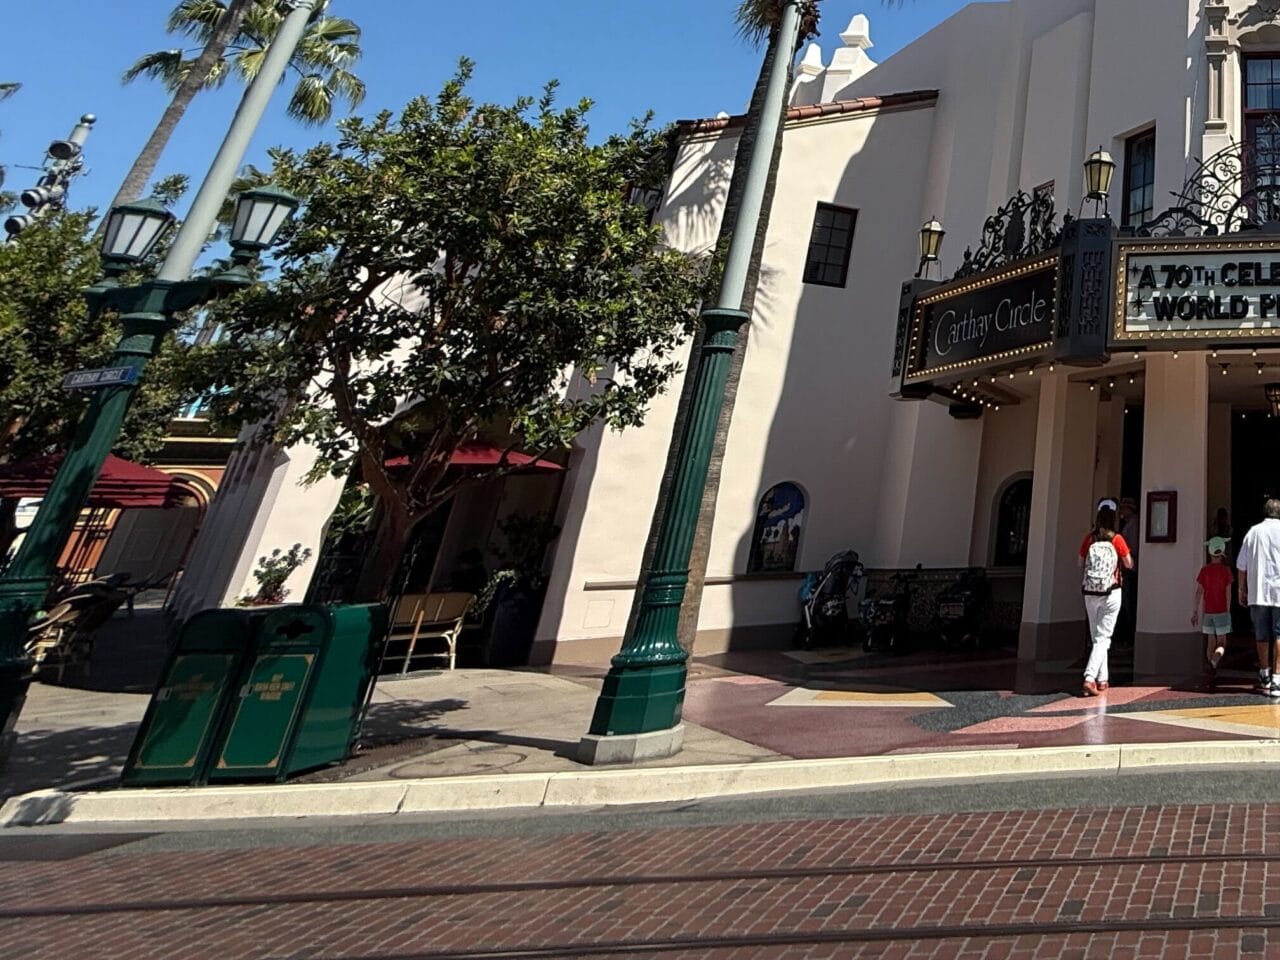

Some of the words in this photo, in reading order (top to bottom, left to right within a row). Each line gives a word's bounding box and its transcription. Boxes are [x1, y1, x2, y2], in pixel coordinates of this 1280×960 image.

[1138, 265, 1157, 289] A
[1161, 265, 1216, 289] 70TH
[1153, 294, 1248, 321] WORLD
[934, 309, 993, 356] Carthay
[995, 290, 1046, 332] Circle
